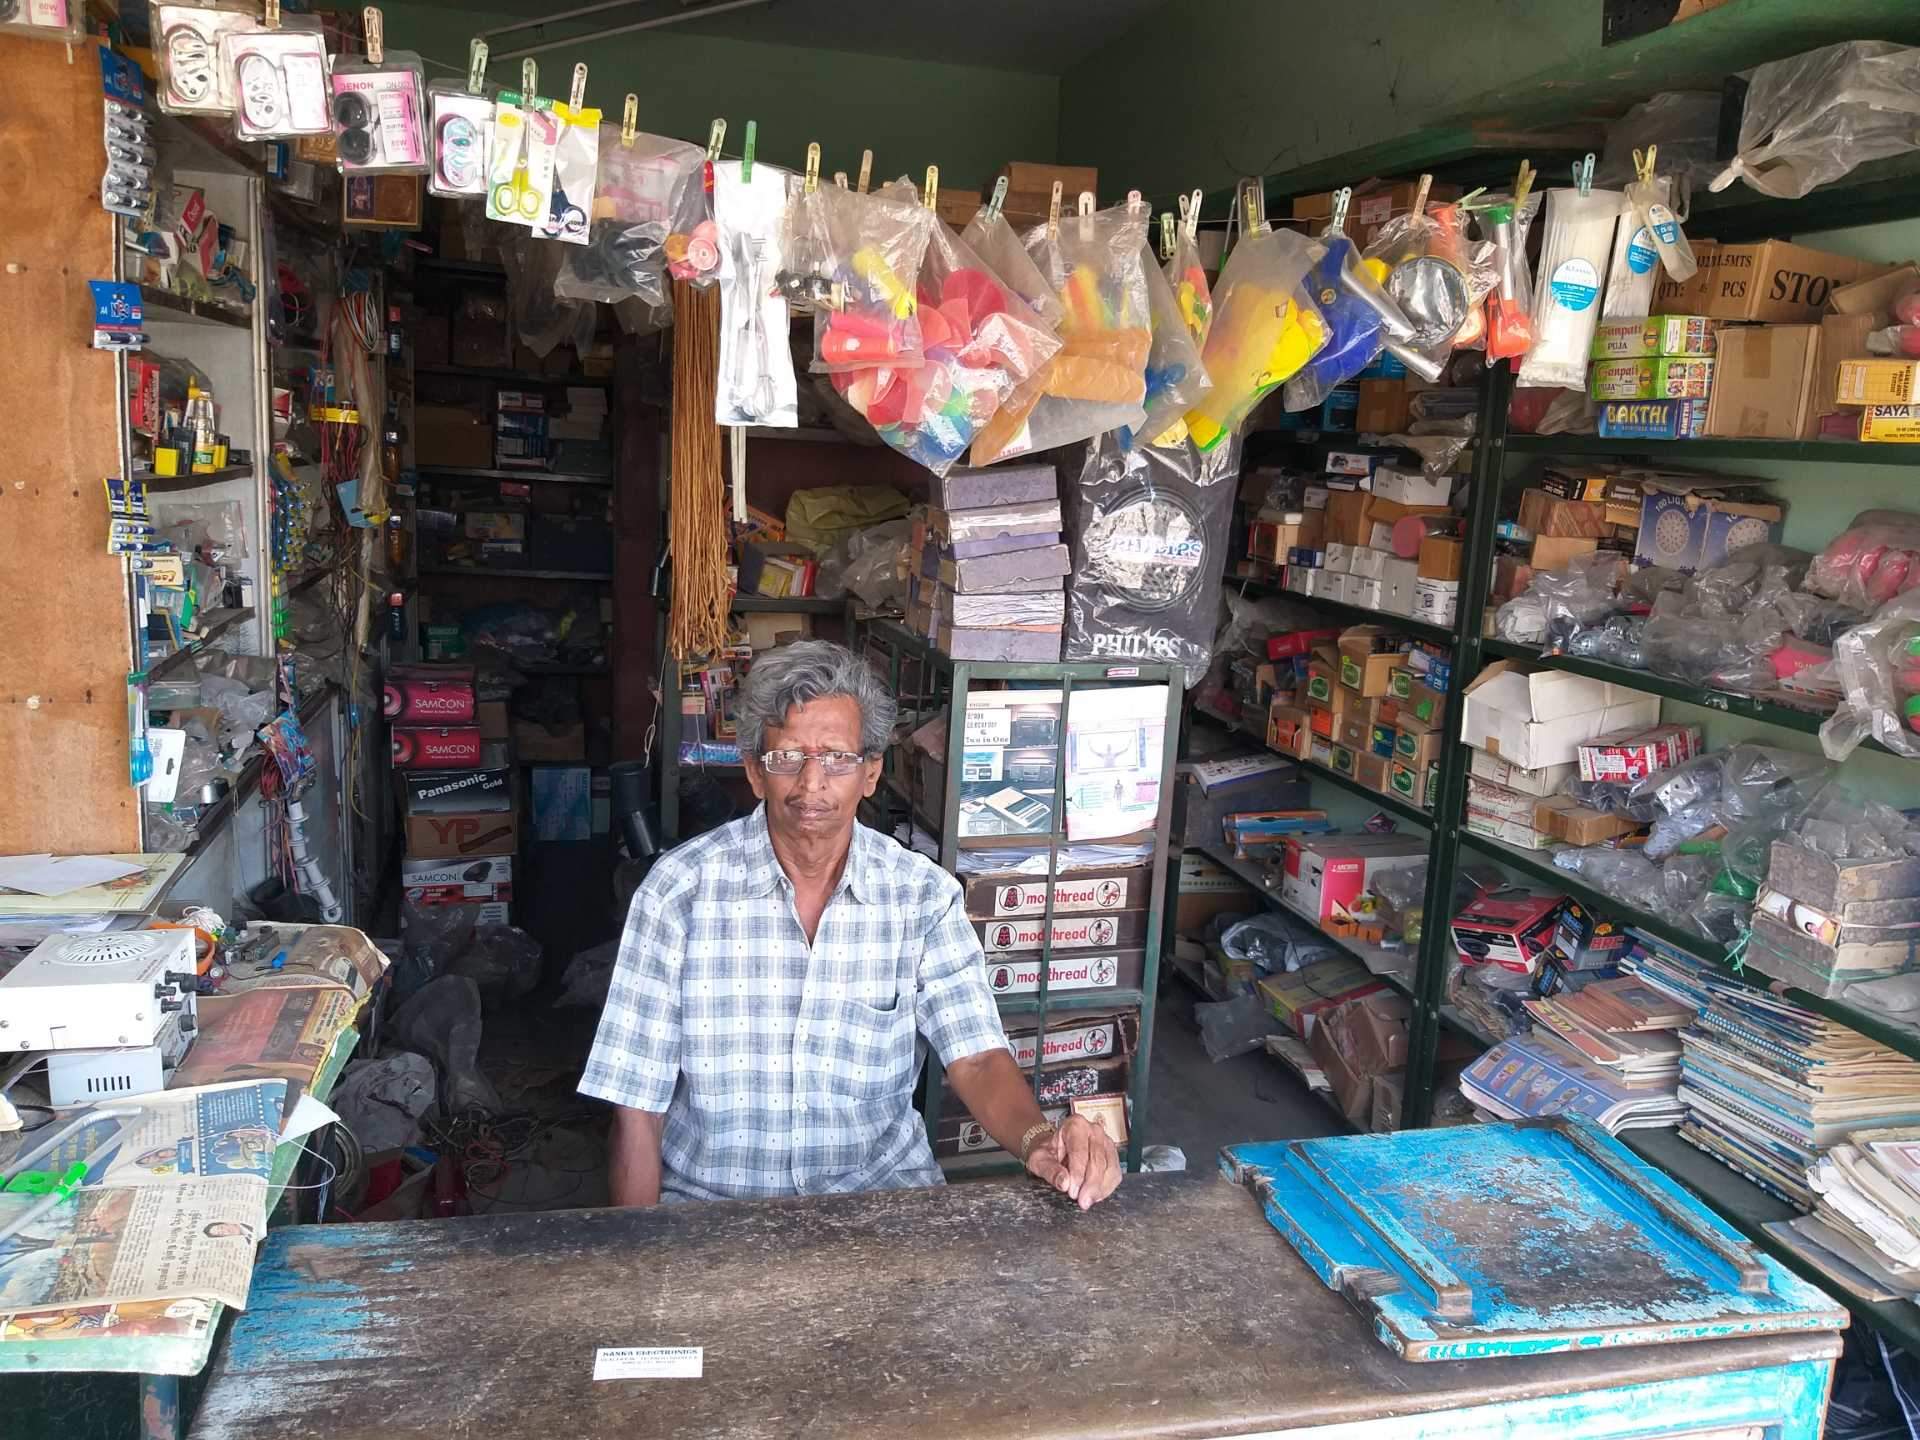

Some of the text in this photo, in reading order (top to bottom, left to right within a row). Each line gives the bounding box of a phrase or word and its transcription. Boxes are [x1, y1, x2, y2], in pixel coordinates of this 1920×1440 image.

[1721, 280, 1746, 298] PCS
[1769, 269, 1838, 307] STO
[1607, 342, 1628, 351] PUJA
[1607, 404, 1669, 425] BAKTHI
[1875, 404, 1910, 416] SAYA
[415, 697, 465, 709] SAMCON
[425, 744, 475, 754] SAMCON
[417, 773, 488, 800] Panasonic
[482, 778, 503, 790] Gold
[412, 873, 457, 883] SAMCON
